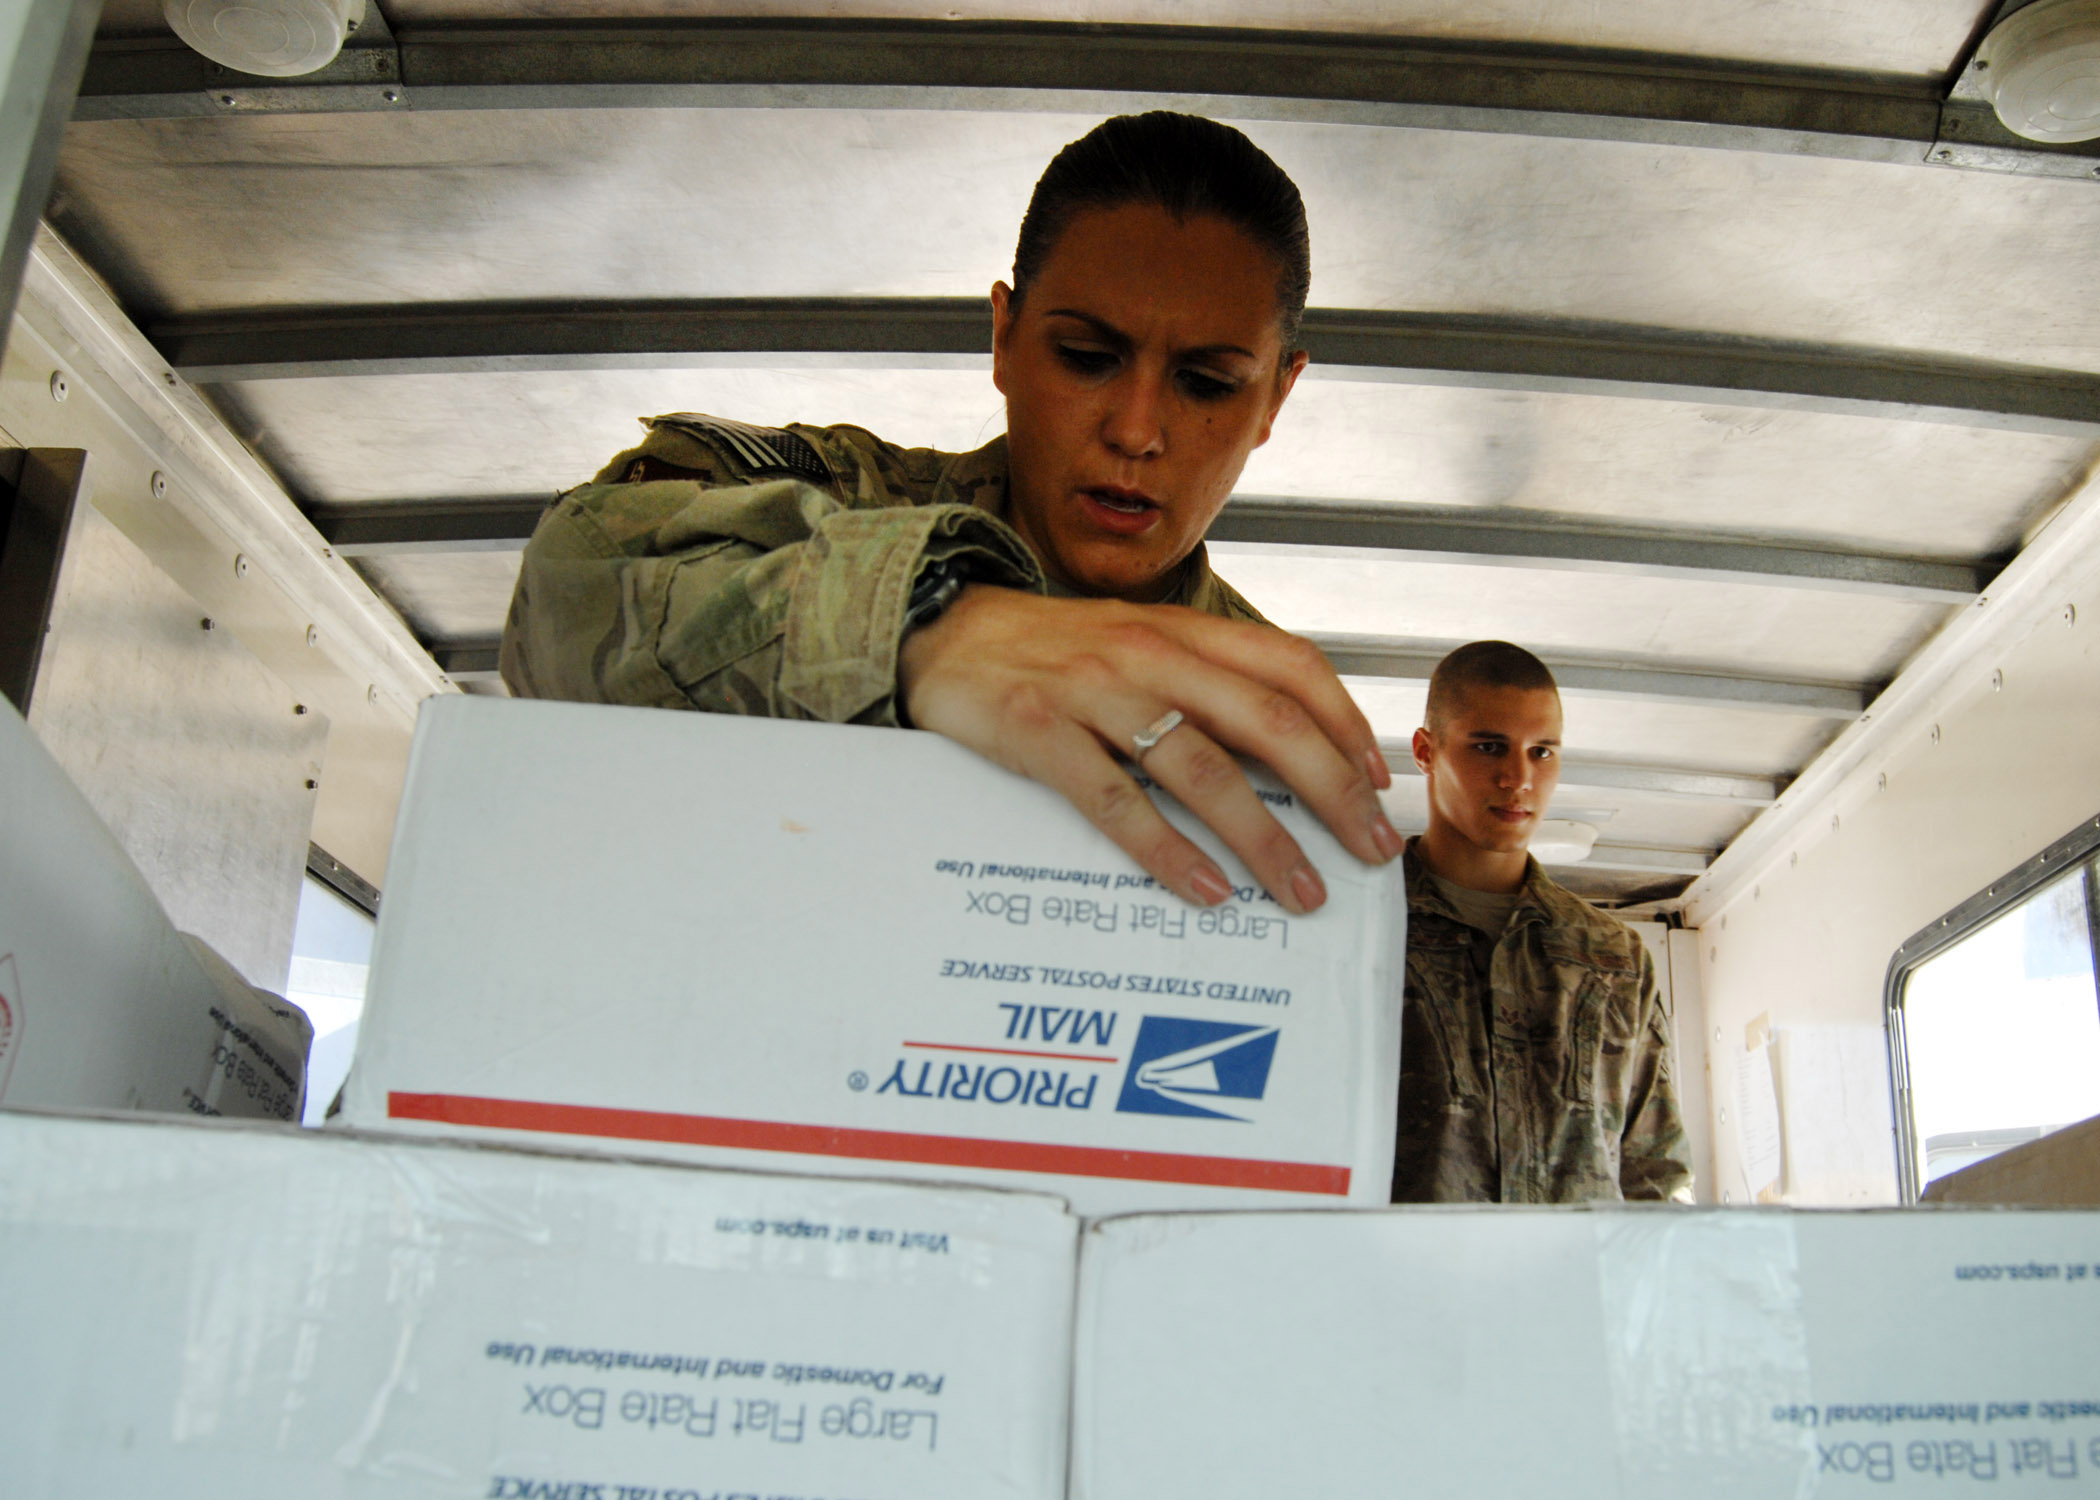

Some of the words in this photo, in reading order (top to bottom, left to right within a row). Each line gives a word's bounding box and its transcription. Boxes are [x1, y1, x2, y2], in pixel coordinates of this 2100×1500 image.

[936, 859, 976, 879] Use
[980, 863, 1111, 890] International
[1115, 873, 1154, 891] and
[965, 891, 1030, 923] Box
[1043, 894, 1118, 932] Rate
[1128, 902, 1186, 939] Flat
[1199, 908, 1289, 948] Large
[939, 959, 1035, 983] SERVICE
[1037, 966, 1121, 991] POSTAL
[1126, 974, 1206, 997] STATES
[1207, 981, 1291, 1005] UNITED
[997, 1003, 1118, 1045] MAIL
[876, 1059, 1099, 1110] PRIORITY
[836, 1226, 860, 1244] at
[867, 1228, 894, 1244] us
[901, 1229, 950, 1253] Visit
[2067, 1265, 2088, 1282] at
[486, 1343, 535, 1363] Use
[542, 1348, 709, 1378] International
[716, 1360, 765, 1379] and
[771, 1363, 894, 1391] Domestic
[901, 1370, 944, 1394] For
[522, 1384, 606, 1430] Box
[621, 1391, 718, 1436] Rate
[732, 1397, 806, 1444] Flat
[1825, 1404, 1979, 1426] International
[1986, 1404, 2031, 1422] and
[820, 1398, 940, 1452] Large
[1817, 1441, 1895, 1483] Box
[1906, 1440, 1998, 1481] Rate
[2009, 1438, 2080, 1480] Flat
